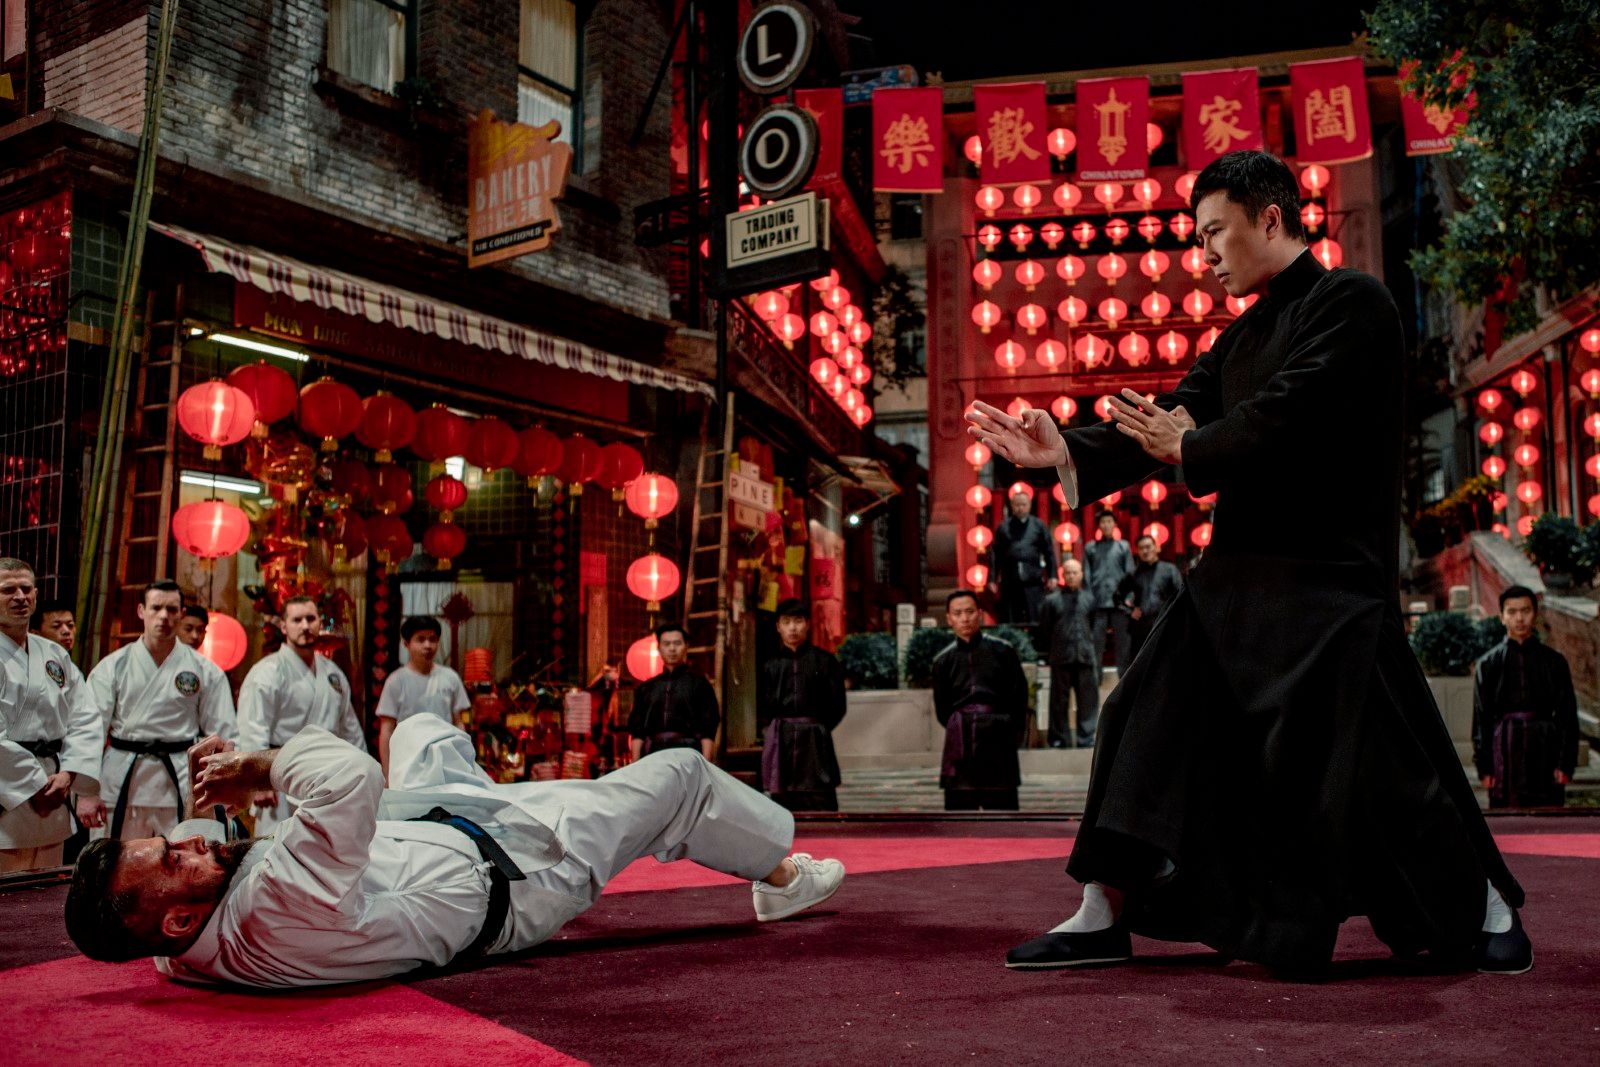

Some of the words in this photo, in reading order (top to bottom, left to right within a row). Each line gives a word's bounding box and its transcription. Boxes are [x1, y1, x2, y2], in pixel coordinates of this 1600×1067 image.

[756, 24, 783, 66] L
[880, 113, 935, 174] 樂
[986, 106, 1042, 168] 歡
[1199, 96, 1252, 154] 家
[755, 128, 790, 169] O
[475, 154, 552, 213] BAKERY
[1080, 169, 1145, 180] CHINATOWN
[488, 226, 543, 249] CONDITIONED
[741, 225, 800, 254] COMPANY
[745, 208, 795, 234] TRADING
[730, 476, 769, 505] PINE
